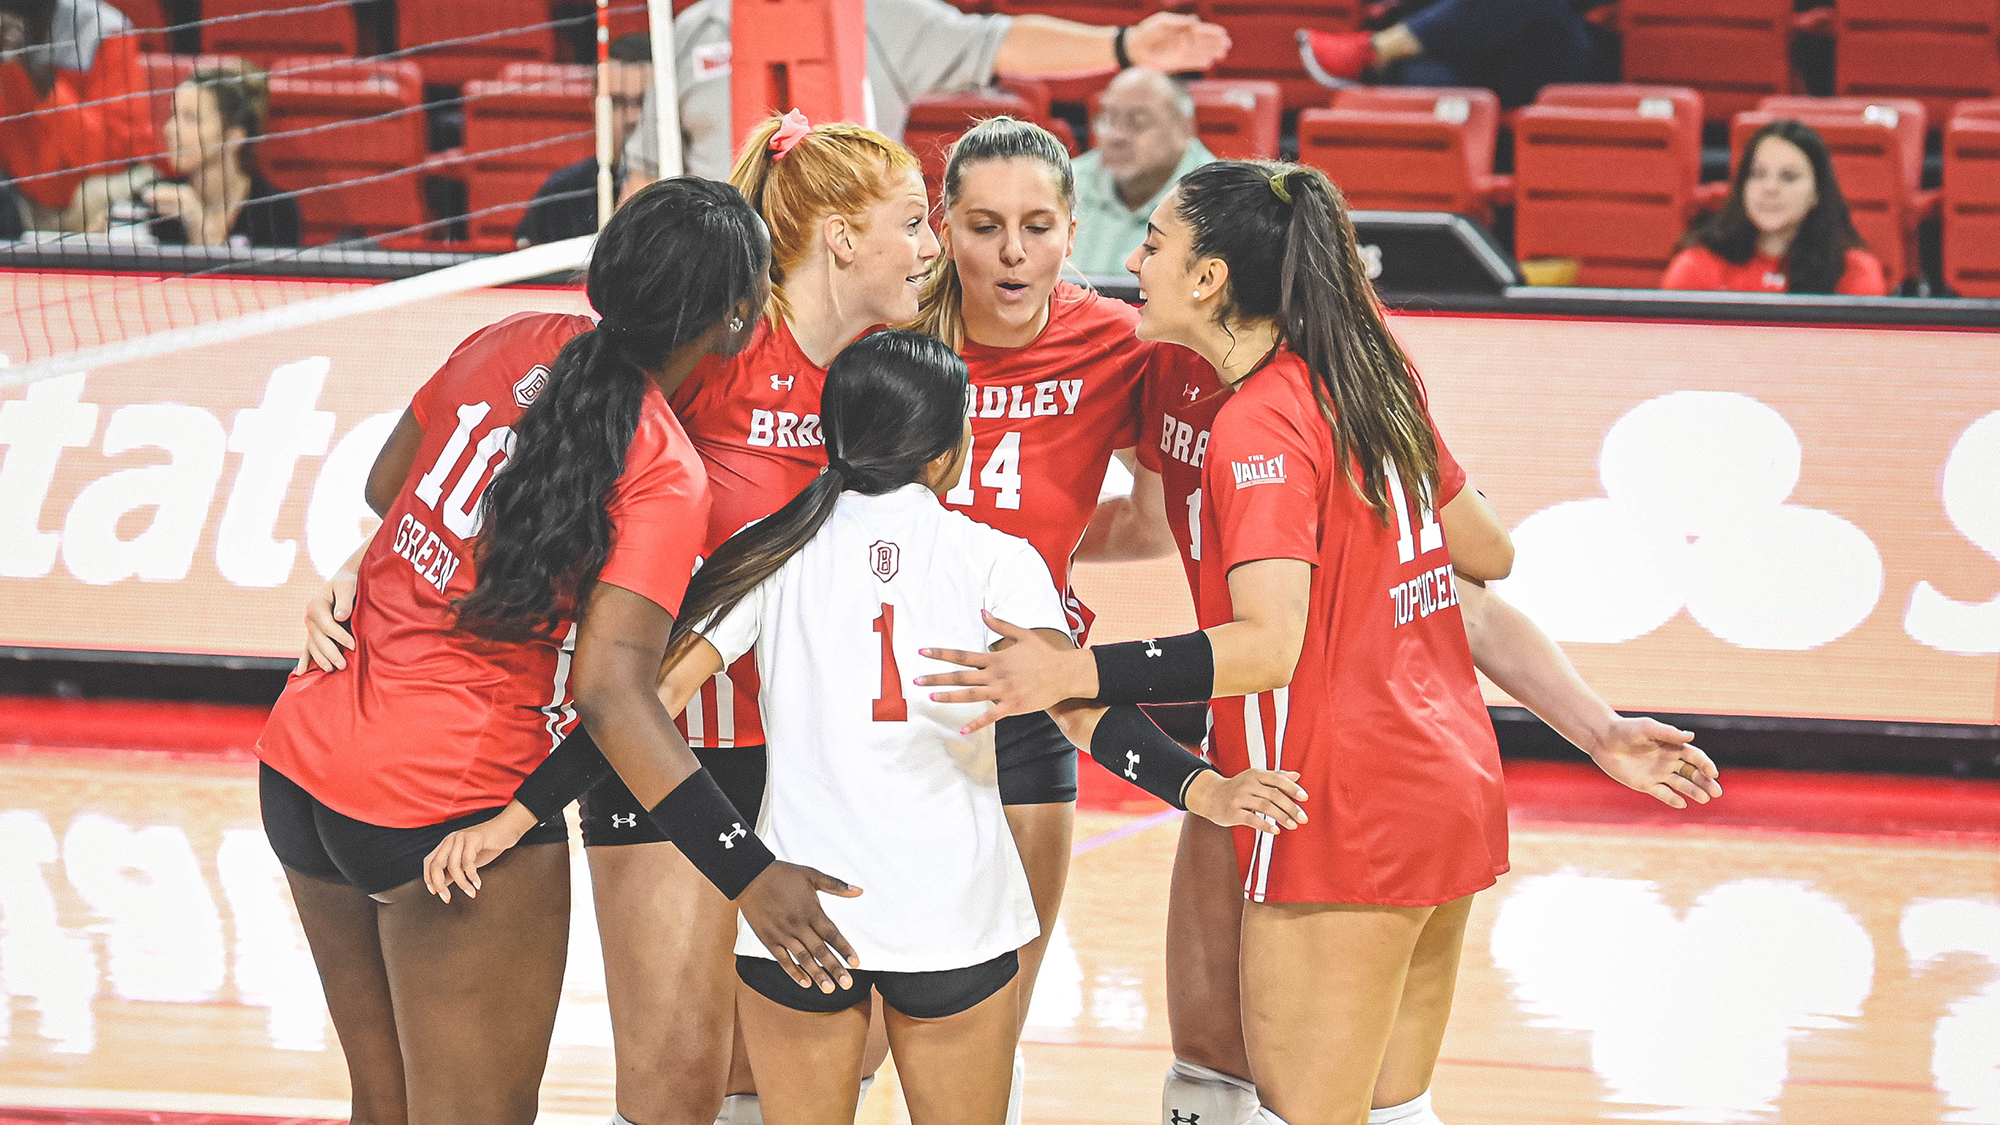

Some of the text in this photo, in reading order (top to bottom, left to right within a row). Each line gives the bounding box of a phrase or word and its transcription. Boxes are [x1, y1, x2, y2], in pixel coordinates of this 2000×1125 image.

[746, 408, 826, 448] BRA
[1247, 454, 1265, 462] THE
[0, 356, 402, 588] tate
[414, 400, 518, 541] 10
[945, 431, 1022, 510] 14
[1383, 457, 1444, 565] 11
[392, 512, 461, 594] GREEN
[877, 546, 892, 575] B
[872, 602, 908, 722] 1
